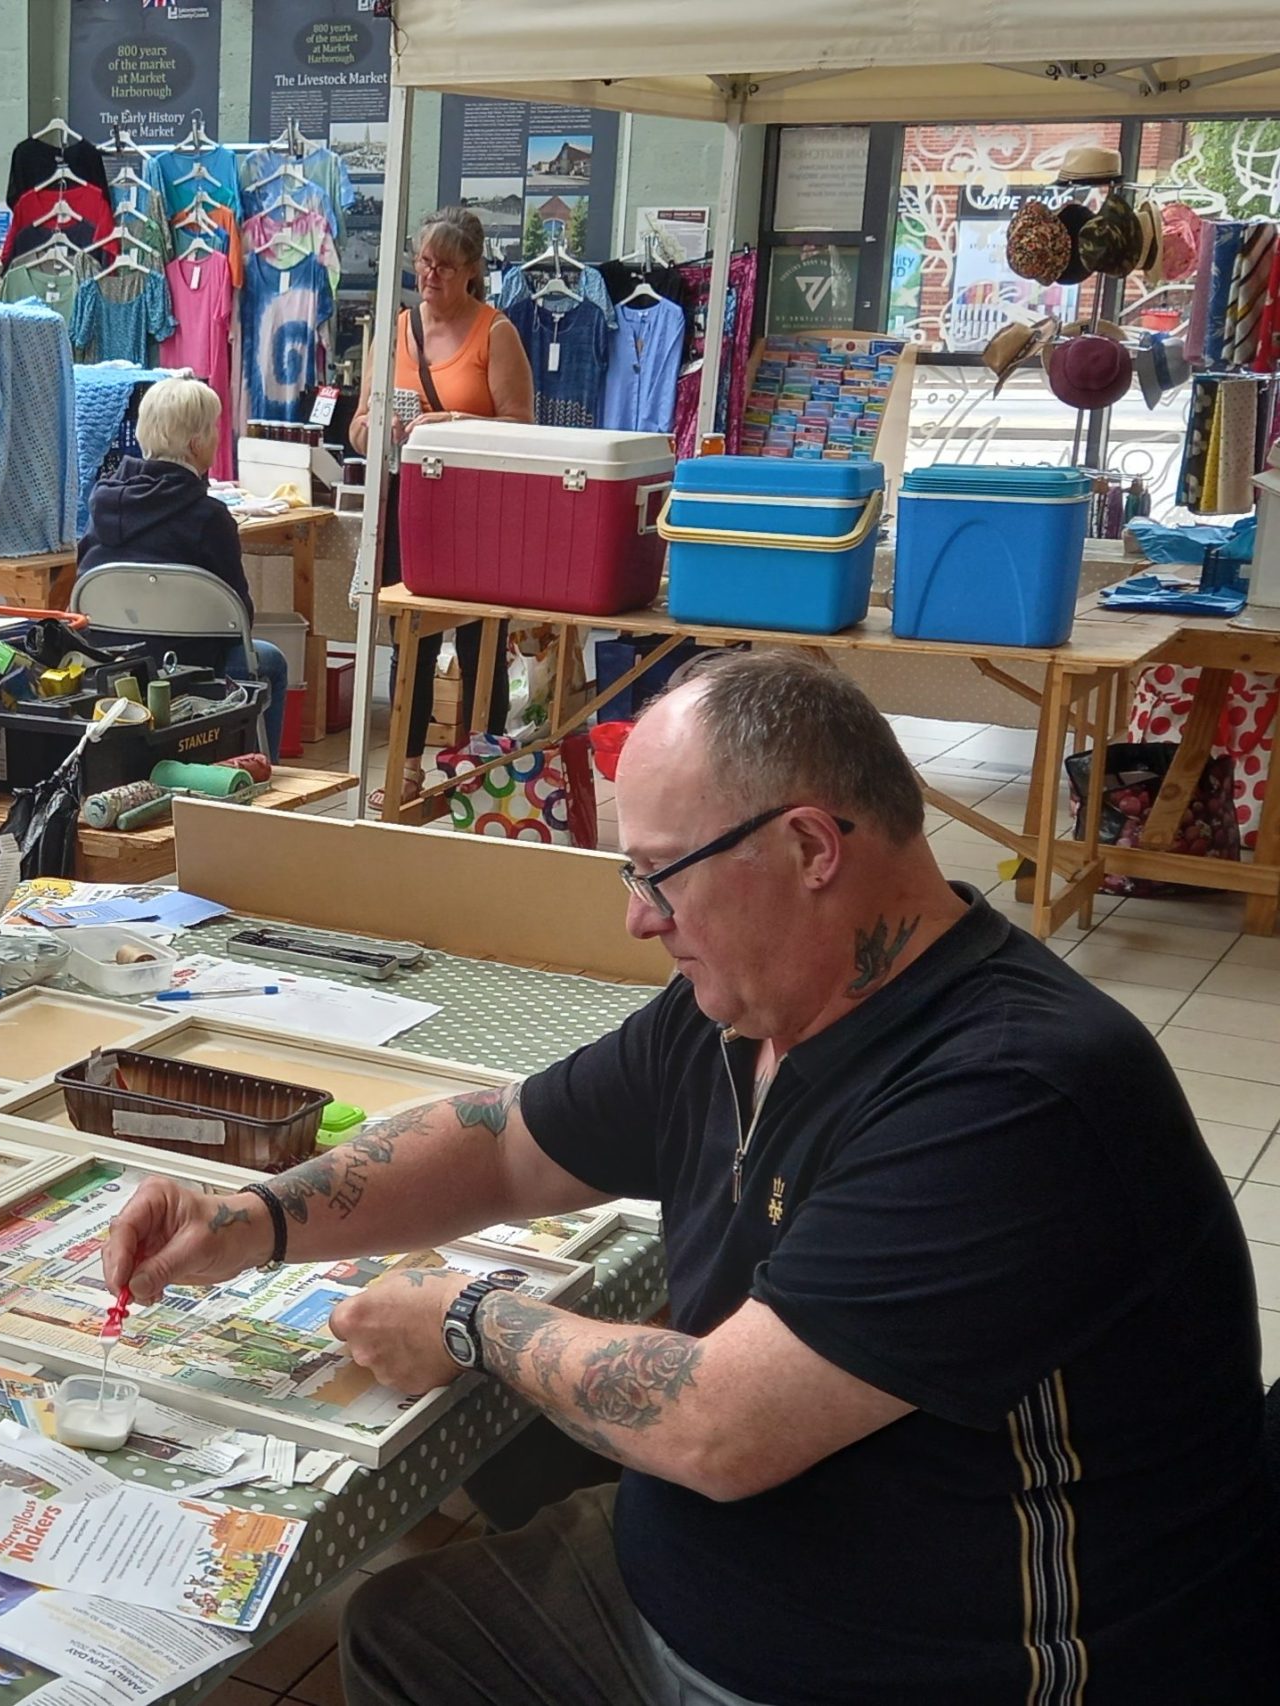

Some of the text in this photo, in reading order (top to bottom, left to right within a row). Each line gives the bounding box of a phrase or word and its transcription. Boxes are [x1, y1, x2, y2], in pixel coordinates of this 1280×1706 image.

[313, 24, 351, 34] 800 years
[306, 33, 359, 43] of the market
[117, 46, 168, 59] 800 years
[313, 44, 350, 53] at Market
[108, 59, 176, 71] of the market
[308, 54, 355, 65] Harborough
[117, 73, 167, 84] at Market
[275, 72, 388, 87] The Livestock Market
[111, 86, 172, 100] Harborough
[100, 112, 185, 126] The Early History
[140, 125, 175, 137] Market
[976, 195, 1021, 210] VAPE
[177, 727, 220, 753] STANLEY
[328, 1153, 368, 1220] ALFIE
[8, 1505, 62, 1563] Makers
[65, 1648, 148, 1695] FAMILY FUN DAY
